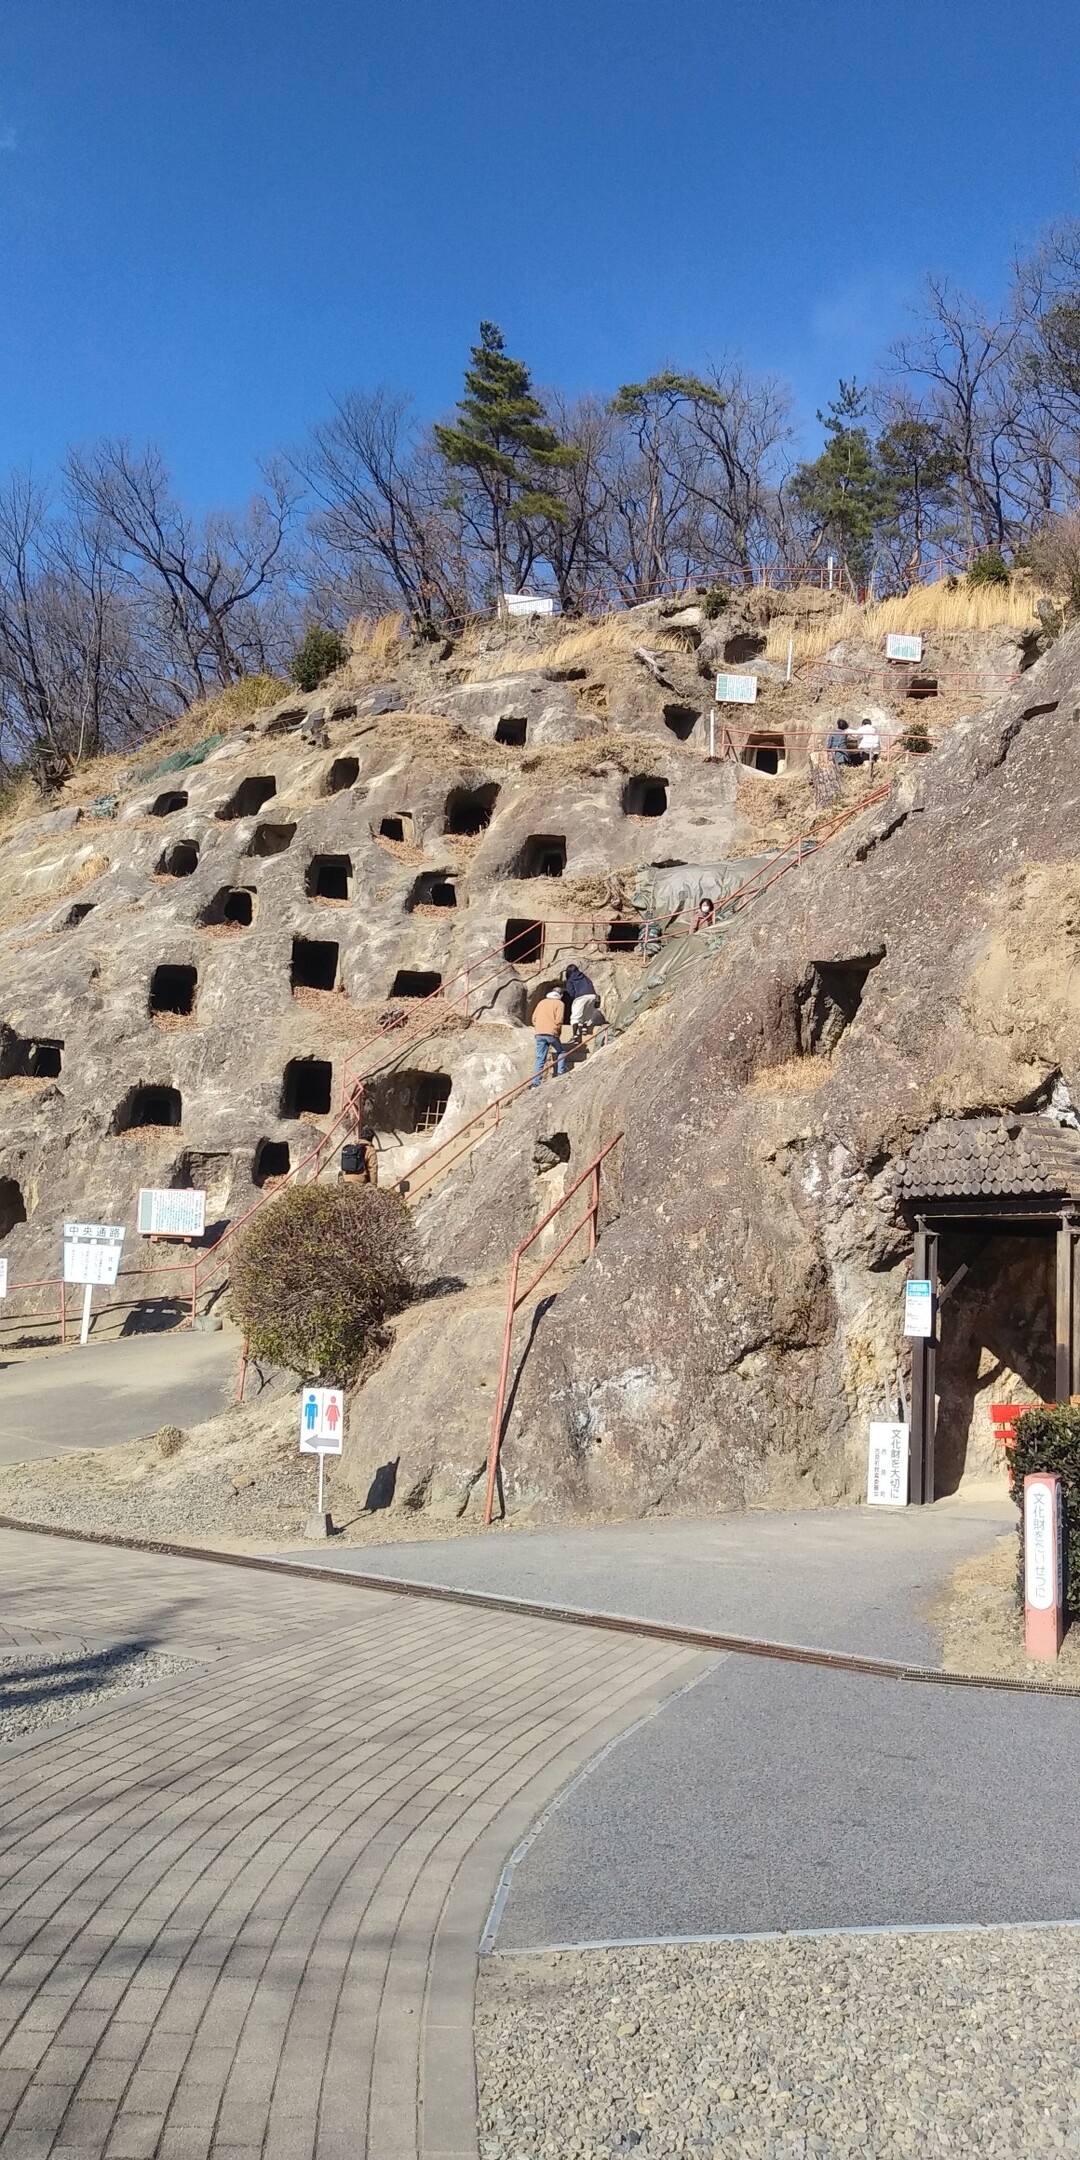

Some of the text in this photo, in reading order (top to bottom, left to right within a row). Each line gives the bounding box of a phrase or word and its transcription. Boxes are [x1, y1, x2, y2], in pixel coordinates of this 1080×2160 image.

[69, 1226, 120, 1238] 中央通路
[890, 1429, 902, 1499] 文化財を大切に
[1033, 1492, 1046, 1599] 文化財をたいせつに
